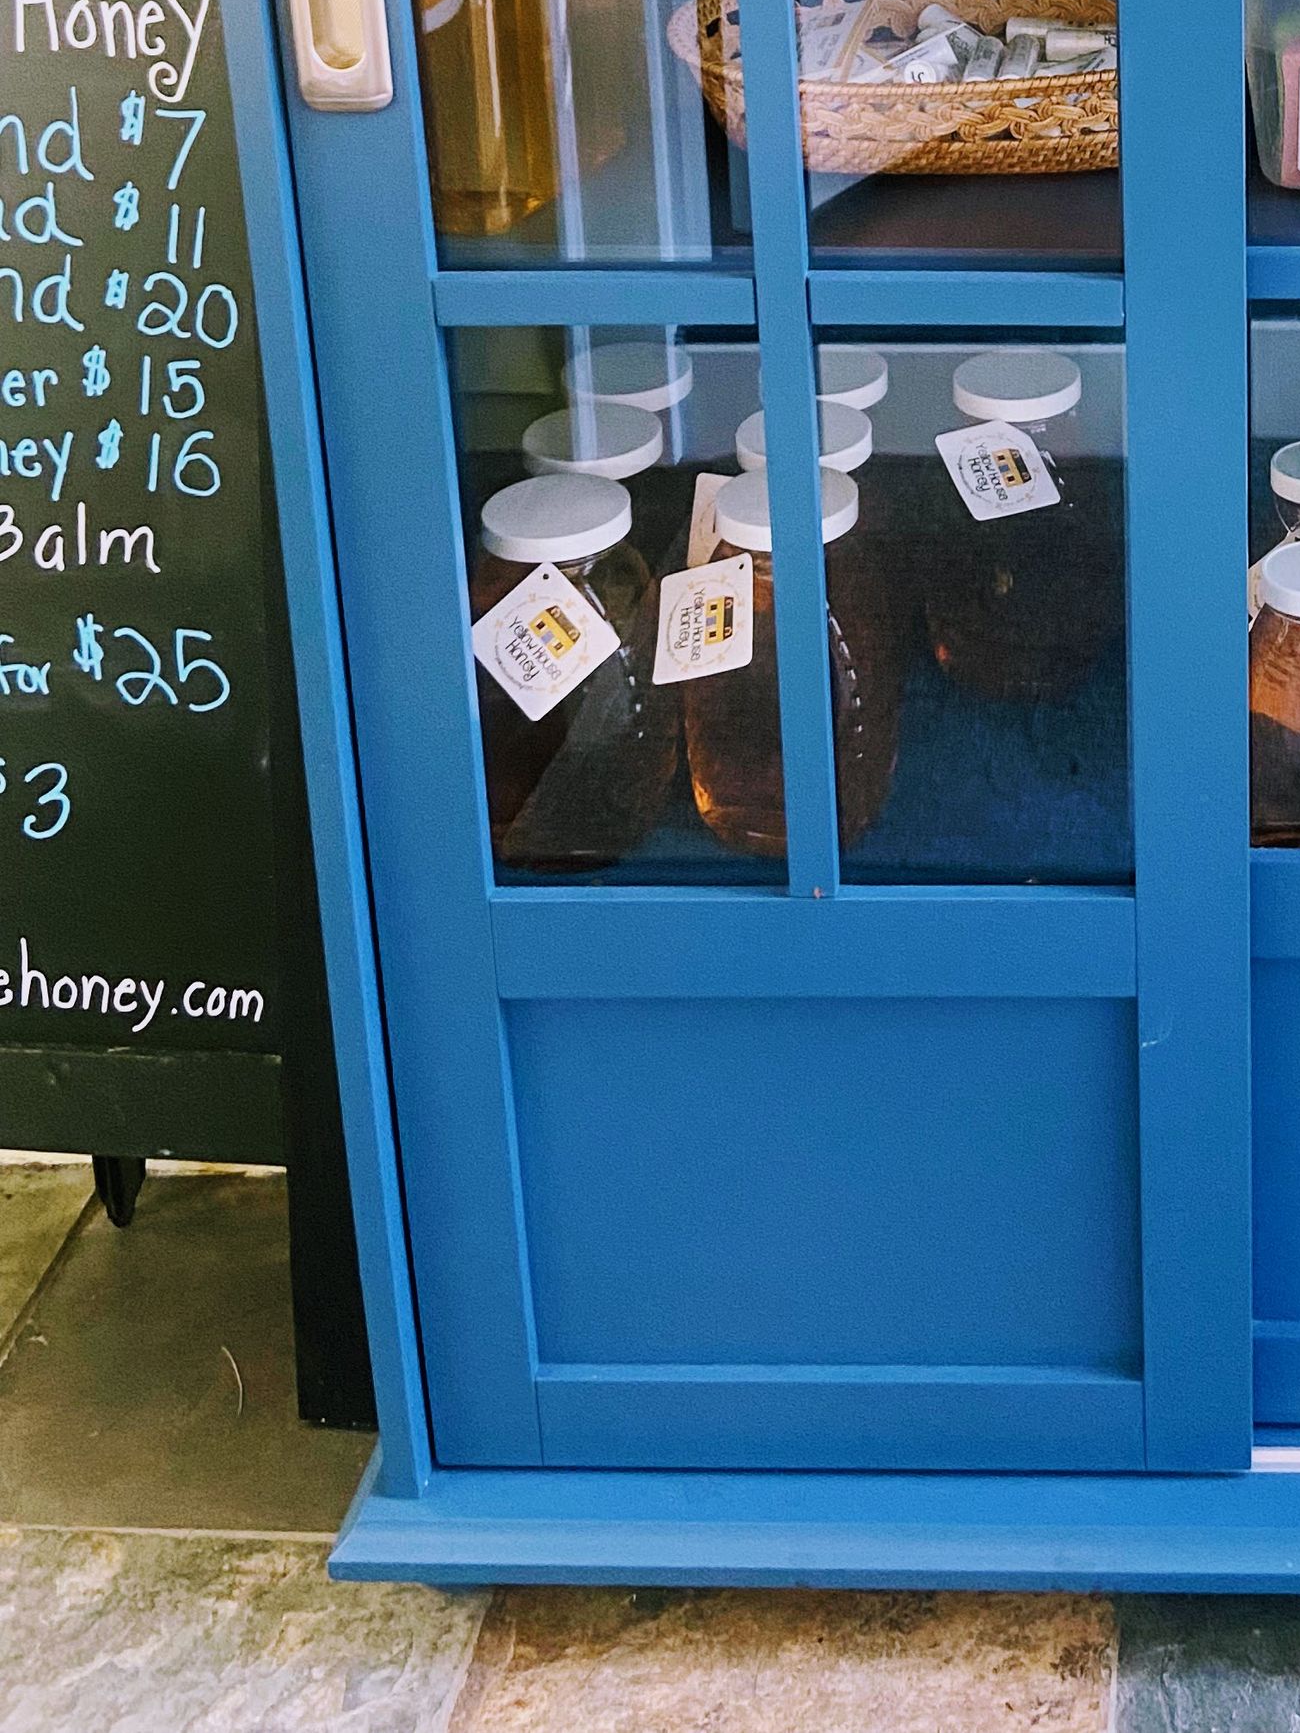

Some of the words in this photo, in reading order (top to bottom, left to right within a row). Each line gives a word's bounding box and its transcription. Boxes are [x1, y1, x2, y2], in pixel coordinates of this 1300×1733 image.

[968, 457, 990, 492] Honey
[976, 441, 995, 471] Yellow
[989, 471, 1008, 501] House
[694, 587, 705, 623] Yellow
[509, 616, 538, 650] Yellow
[533, 646, 562, 681] House
[674, 606, 692, 650] Honey
[690, 626, 703, 661] House
[73, 612, 231, 713] $25
[505, 638, 540, 682] Honey
